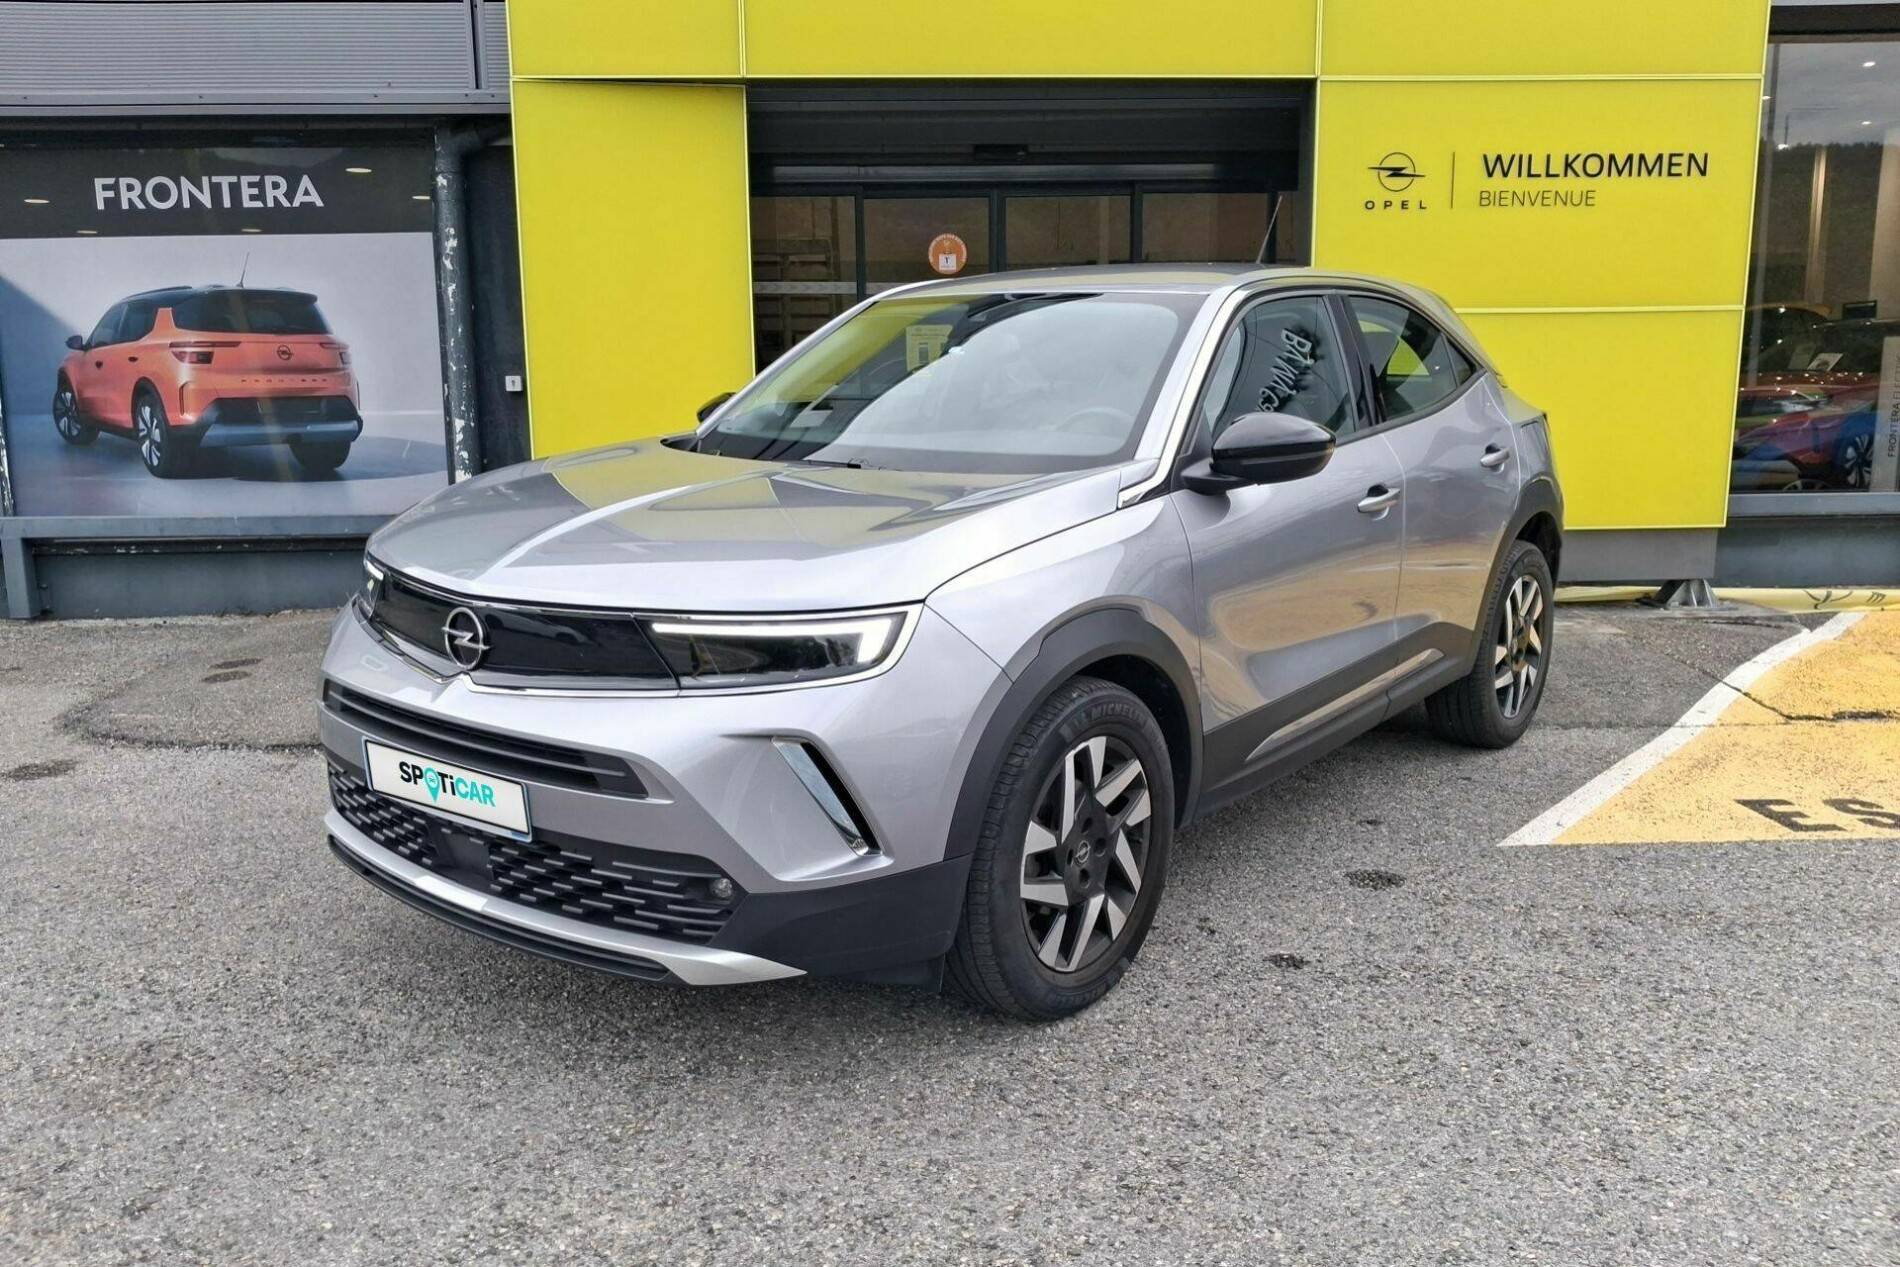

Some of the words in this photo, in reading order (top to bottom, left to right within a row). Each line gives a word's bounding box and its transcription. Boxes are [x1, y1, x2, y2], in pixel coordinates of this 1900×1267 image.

[1482, 153, 1709, 178] WILLKOMMEN
[94, 174, 325, 210] FRONTERA
[1479, 190, 1597, 207] BIENVENUE
[1364, 200, 1427, 210] OPEL
[1887, 400, 1900, 458] FRONTERA
